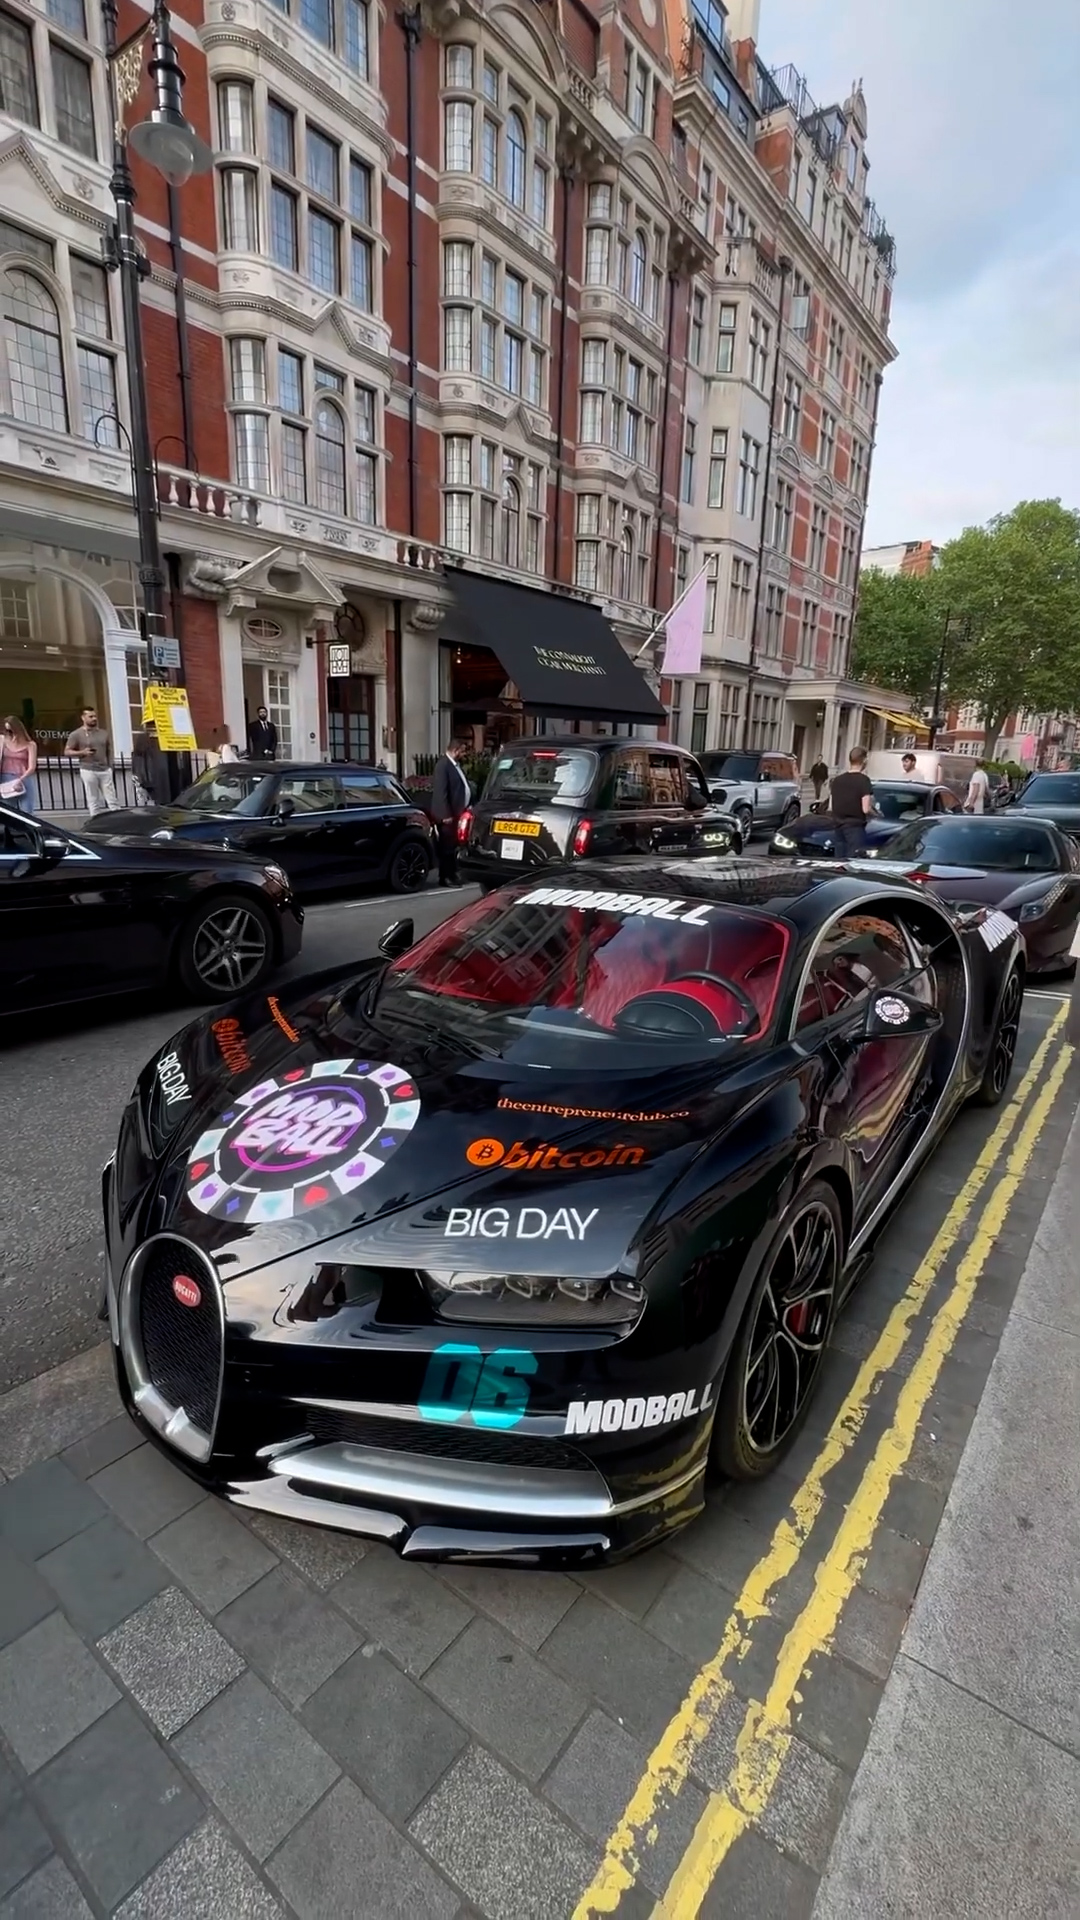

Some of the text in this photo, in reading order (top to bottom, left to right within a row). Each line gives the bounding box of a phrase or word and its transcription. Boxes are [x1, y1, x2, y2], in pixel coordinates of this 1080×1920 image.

[514, 888, 715, 926] MODBALL
[156, 1051, 192, 1106] BIG DAY
[229, 1117, 348, 1157] BALL
[503, 1141, 645, 1169] bitcoin
[444, 1207, 600, 1241] BIG DAY
[175, 1280, 197, 1304] BUGATTI
[417, 1343, 539, 1430] 06
[564, 1383, 714, 1435] MODBALL
